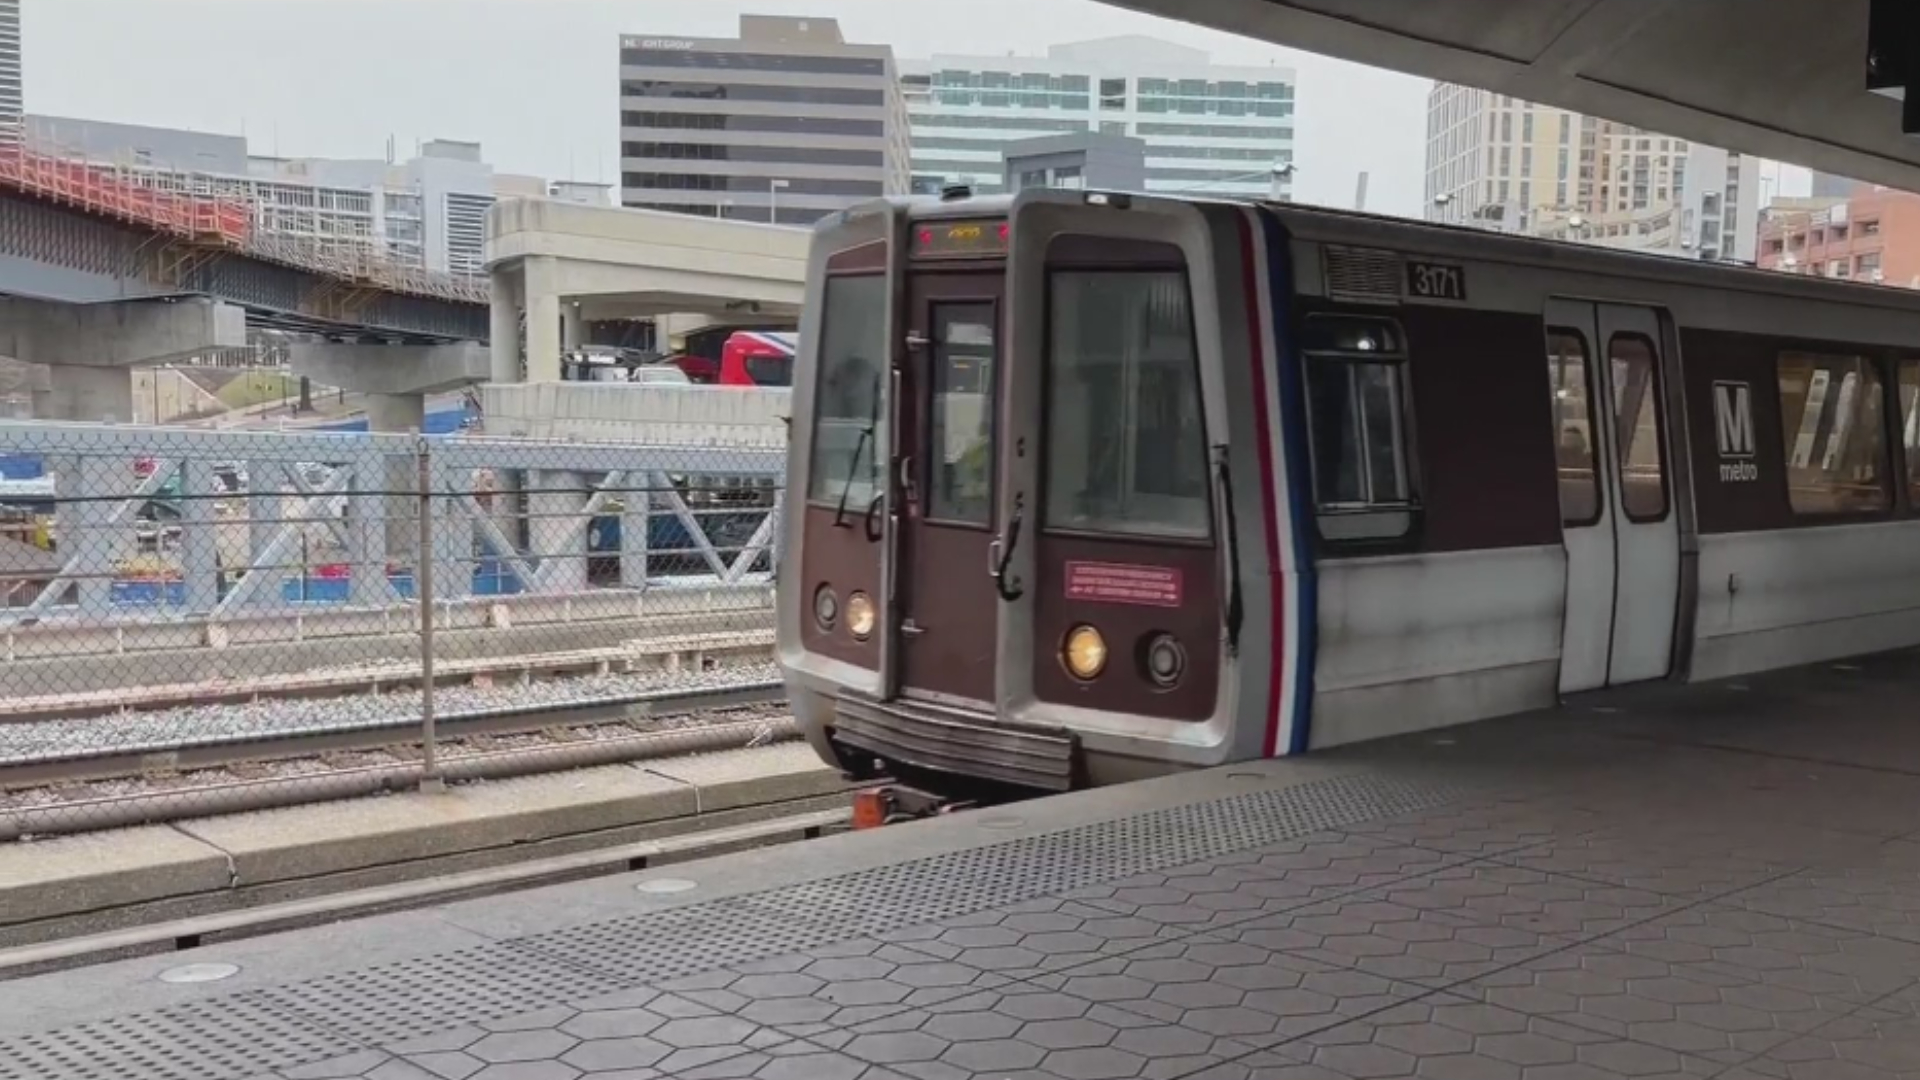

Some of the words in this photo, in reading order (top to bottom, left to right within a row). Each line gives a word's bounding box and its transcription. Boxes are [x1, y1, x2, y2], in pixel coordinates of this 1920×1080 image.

[1416, 264, 1460, 298] 3171
[1714, 385, 1753, 453] M
[1719, 460, 1758, 481] metro
